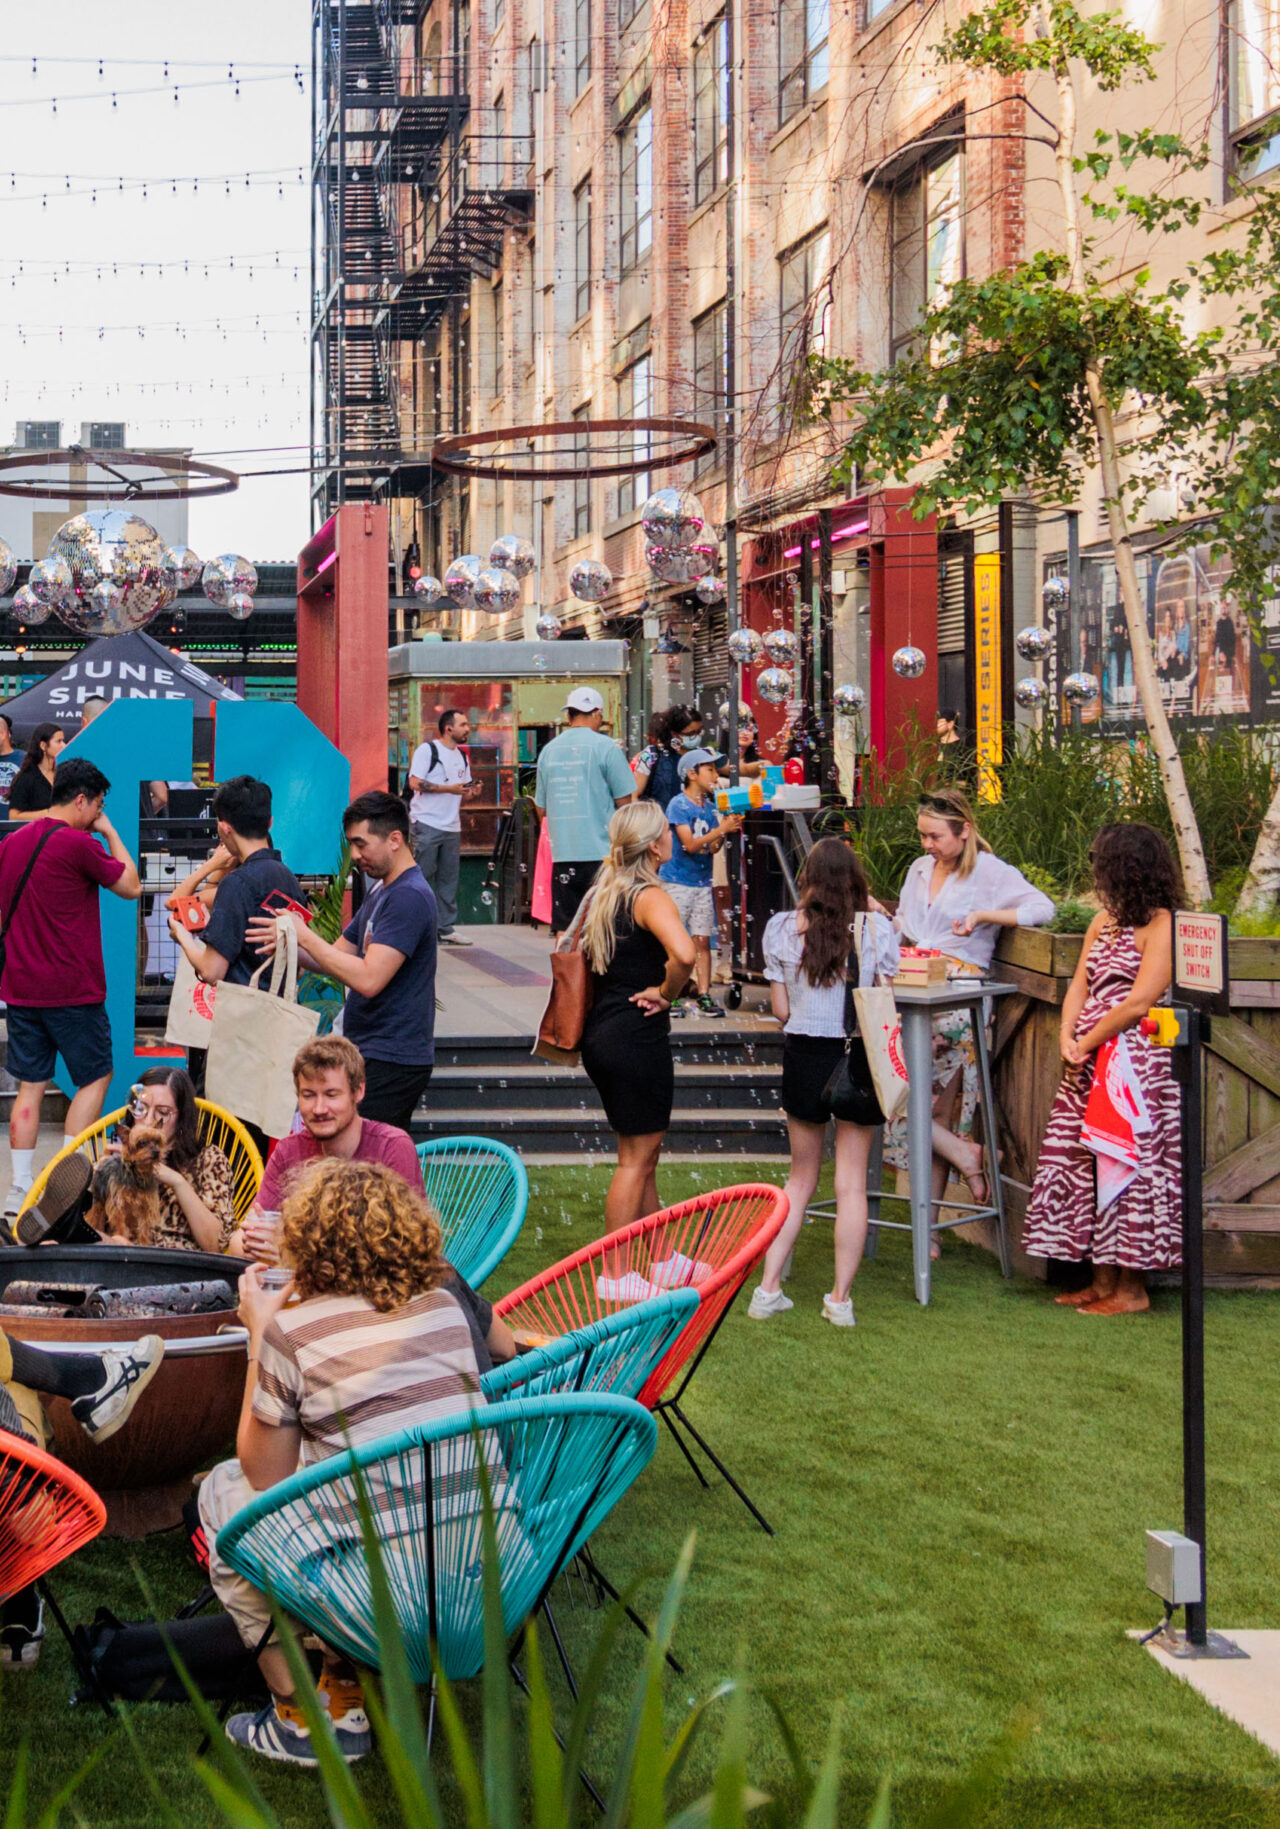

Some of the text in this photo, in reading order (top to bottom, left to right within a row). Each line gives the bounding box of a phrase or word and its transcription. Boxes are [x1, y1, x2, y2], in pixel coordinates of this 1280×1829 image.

[61, 661, 174, 685] JUNE
[1179, 924, 1217, 940] EMERGENCY
[1183, 943, 1213, 959] SHUT OFF
[1186, 962, 1210, 979] SWITCH
